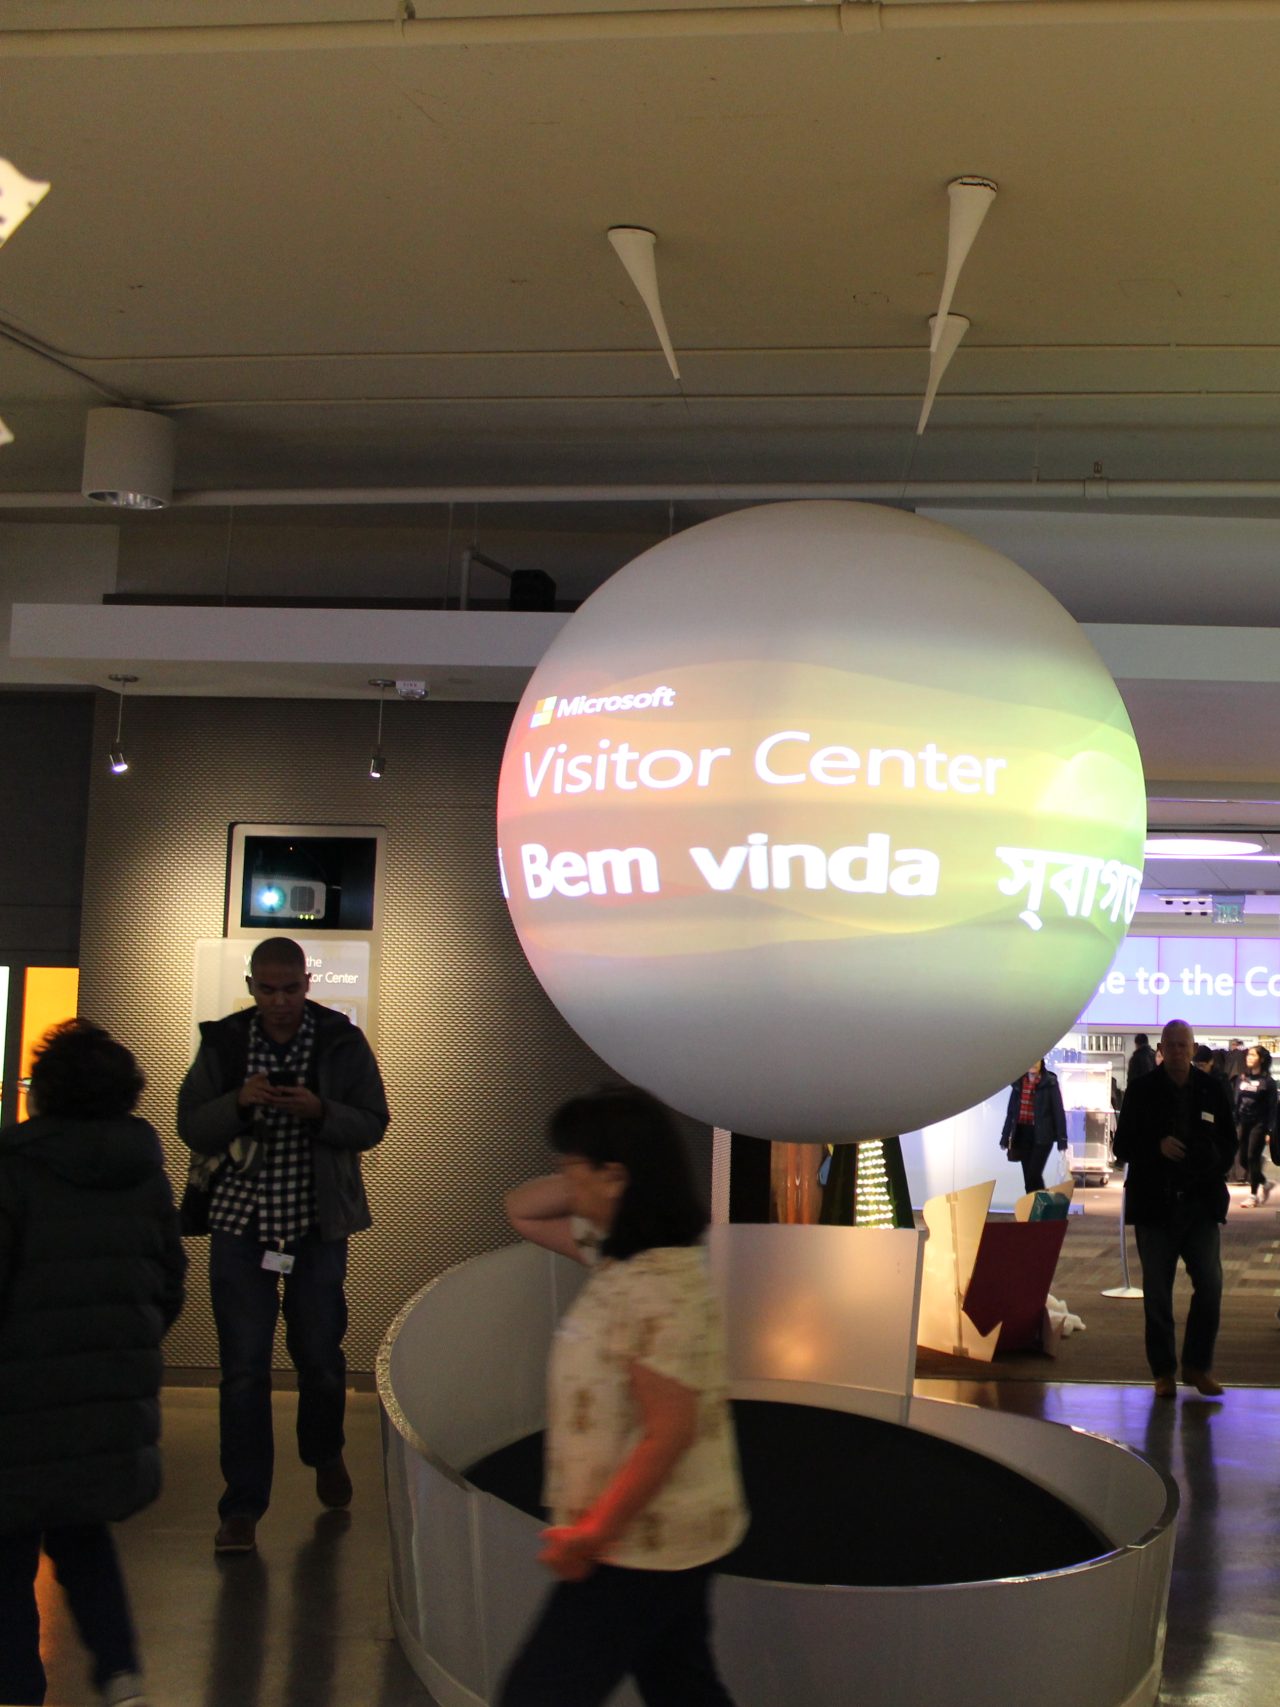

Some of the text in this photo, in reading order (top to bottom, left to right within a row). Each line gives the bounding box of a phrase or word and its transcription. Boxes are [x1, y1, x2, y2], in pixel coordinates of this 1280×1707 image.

[556, 685, 676, 718] Microsoft
[523, 730, 1008, 798] Visitor Center
[520, 843, 661, 900] Bem
[688, 832, 941, 897] vinda
[325, 971, 359, 985] Center
[1135, 966, 1171, 996] to
[1179, 963, 1235, 997] the
